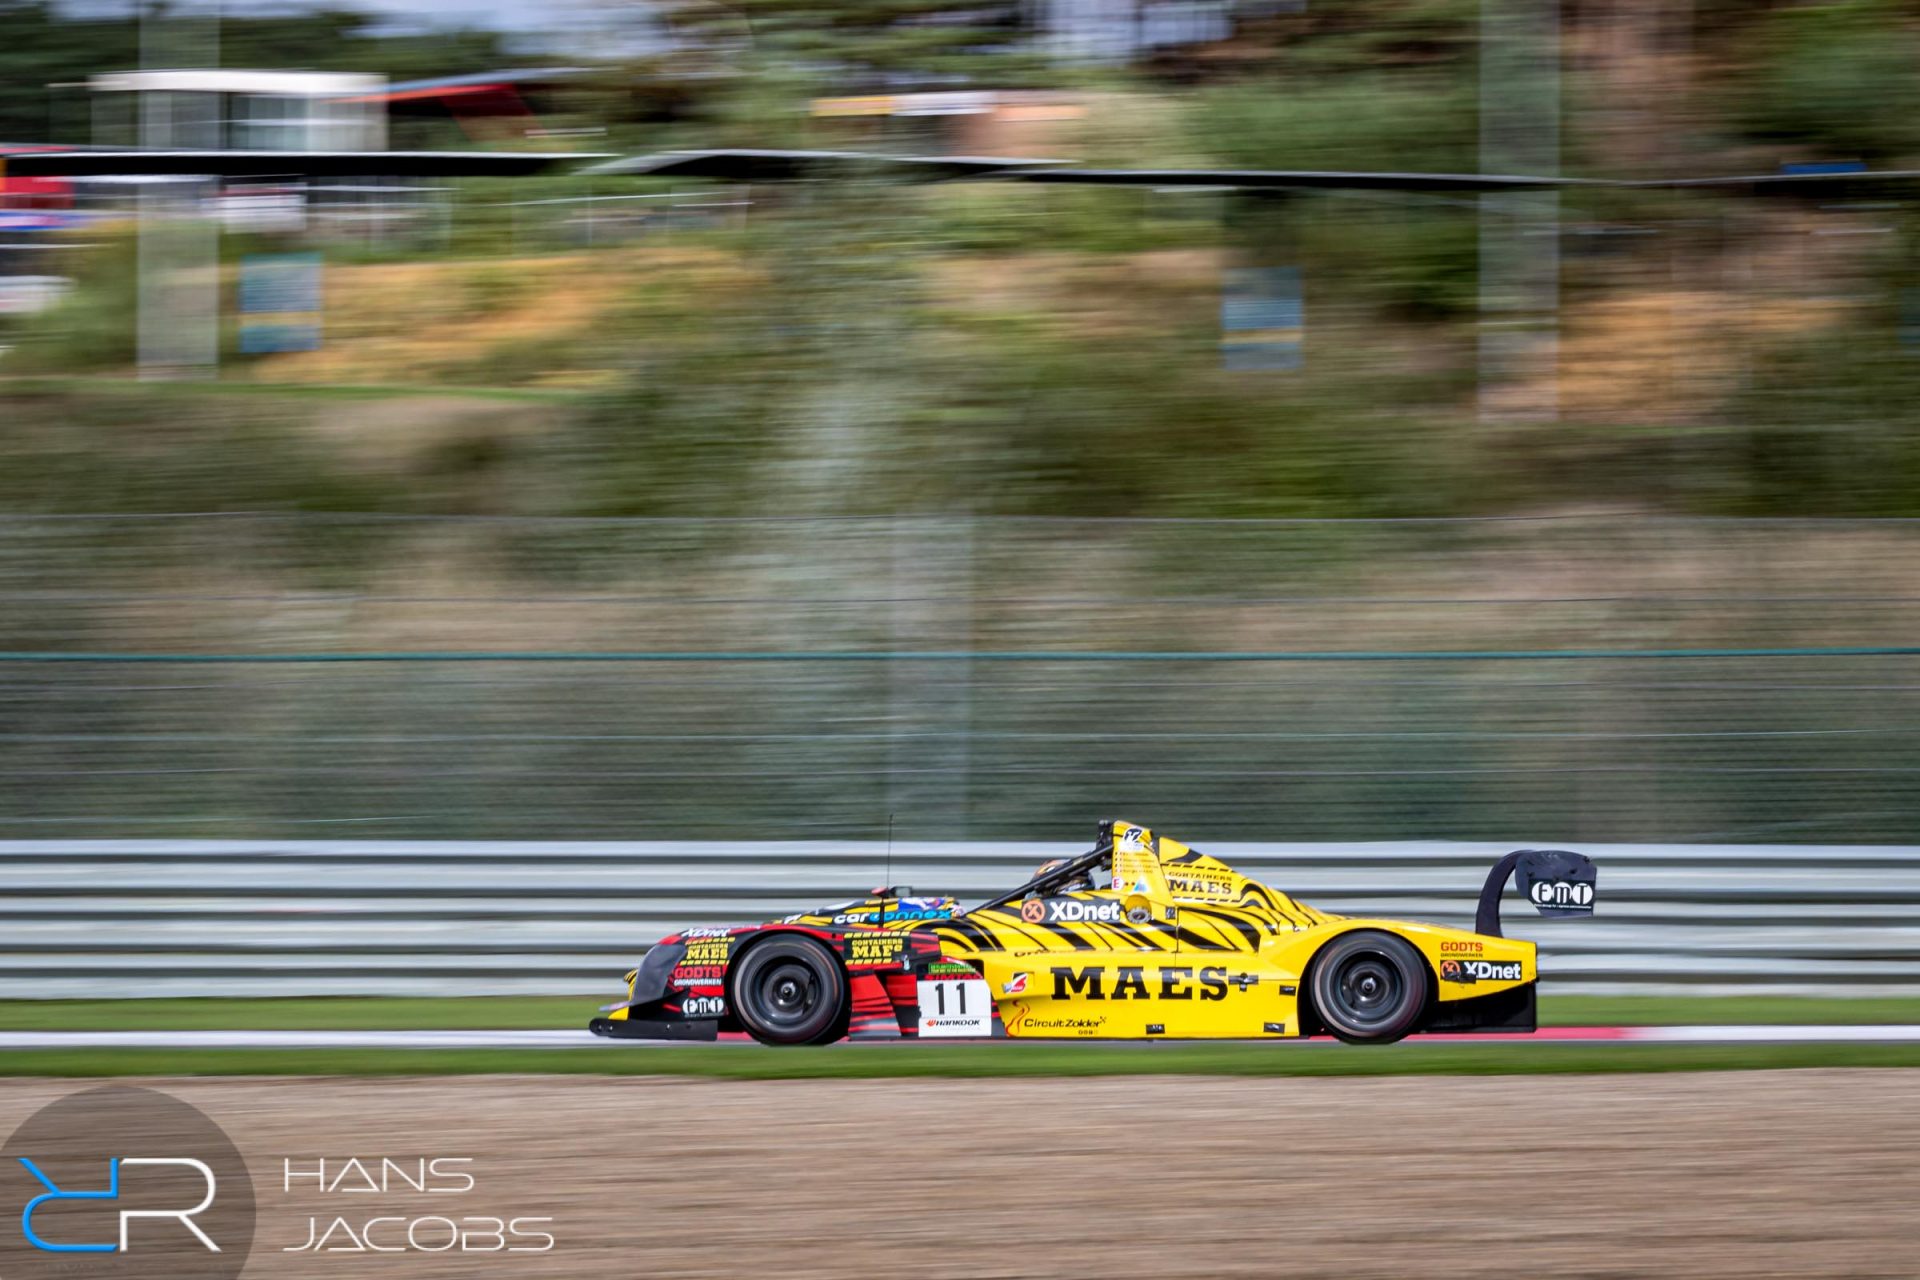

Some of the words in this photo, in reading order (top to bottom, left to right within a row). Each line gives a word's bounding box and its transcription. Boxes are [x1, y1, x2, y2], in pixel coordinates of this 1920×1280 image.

[1169, 879, 1232, 894] MAES
[1049, 901, 1120, 921] XDnet
[687, 948, 728, 959] MAES
[1440, 941, 1483, 952] GODTS
[674, 966, 721, 978] GODTS
[1463, 961, 1521, 979] XDnet
[1050, 966, 1228, 1001] MAES
[935, 982, 966, 1015] 11
